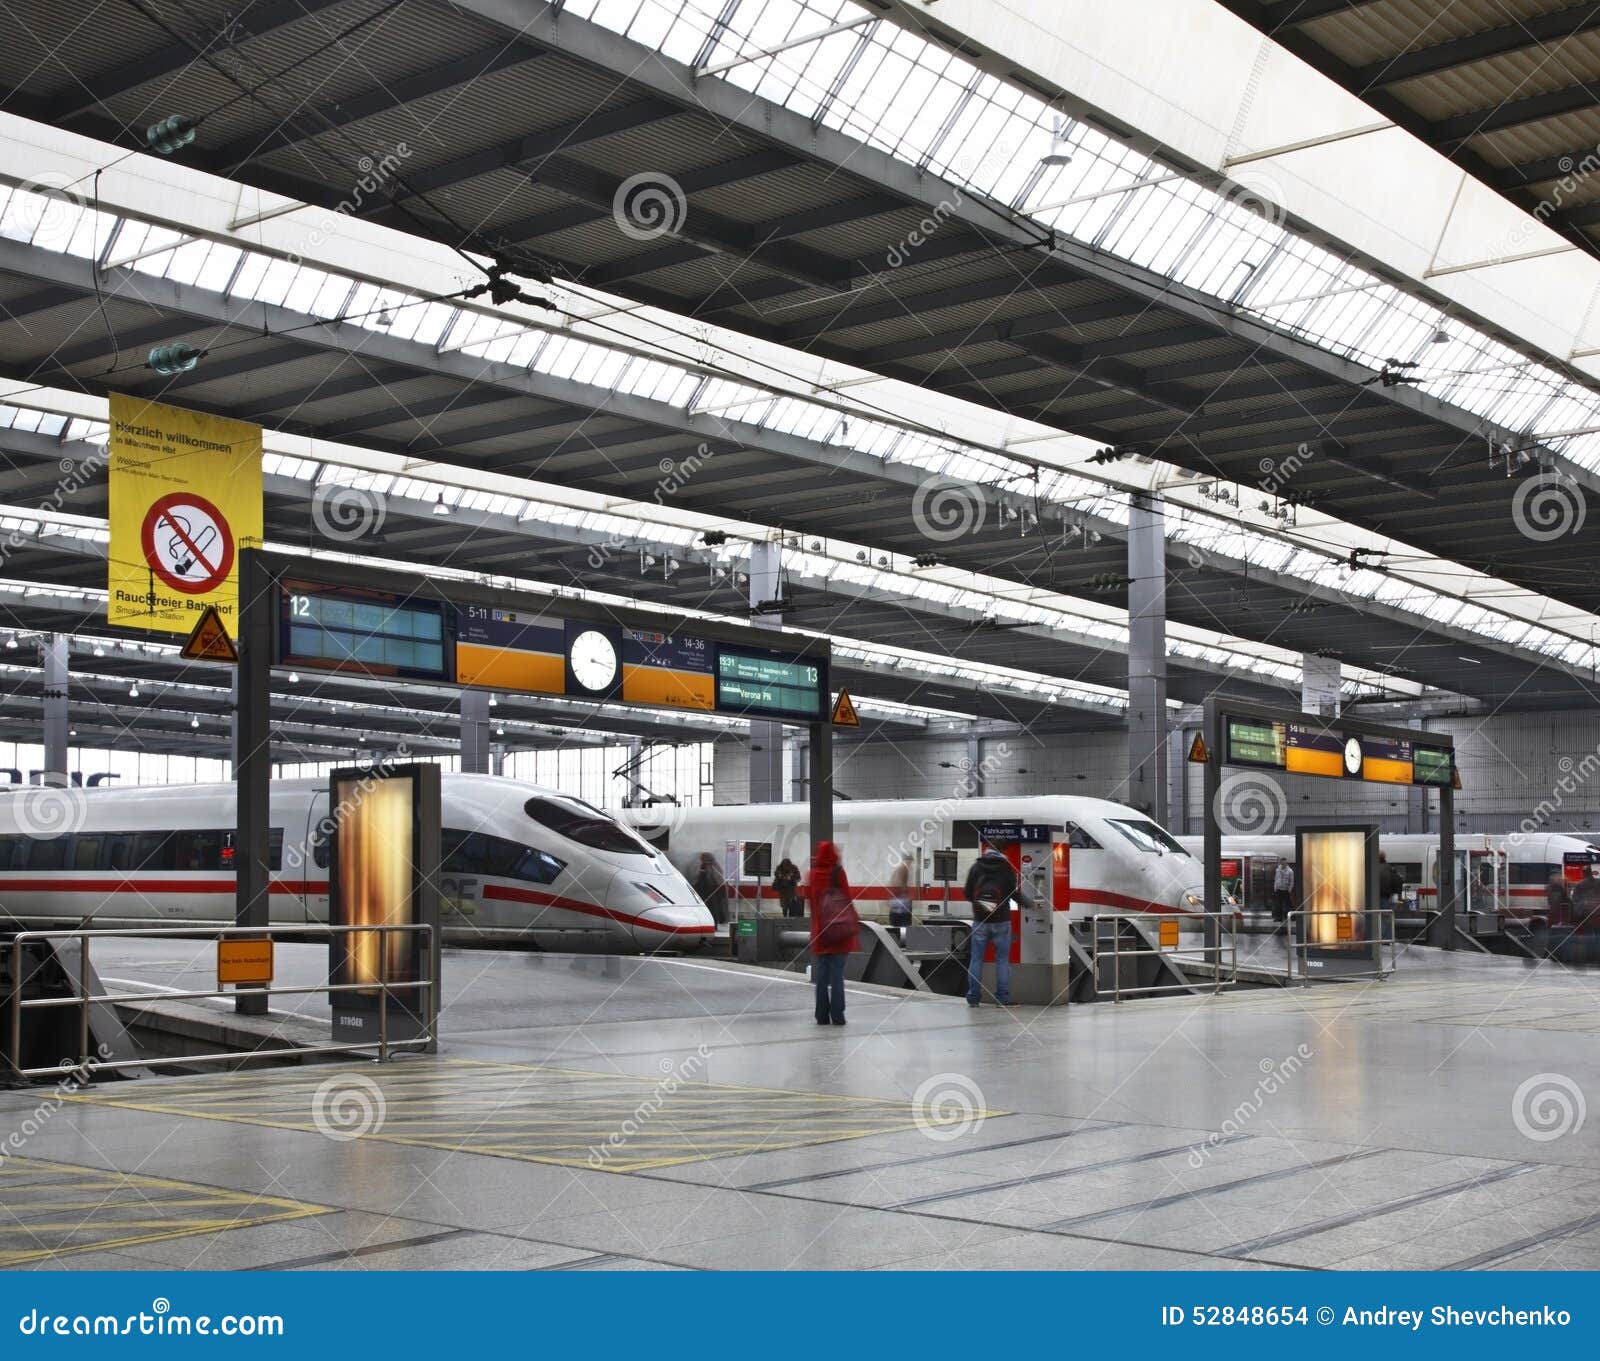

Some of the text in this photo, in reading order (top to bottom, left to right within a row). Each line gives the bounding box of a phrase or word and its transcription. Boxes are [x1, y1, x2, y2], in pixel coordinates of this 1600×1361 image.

[116, 421, 232, 454] Herzlich willkommen
[116, 590, 232, 614] Raucfreier Bahhof
[290, 595, 310, 617] 12
[469, 606, 487, 620] 5-11
[684, 638, 705, 650] 14-36
[806, 666, 818, 683] 13
[740, 689, 761, 701] Verona
